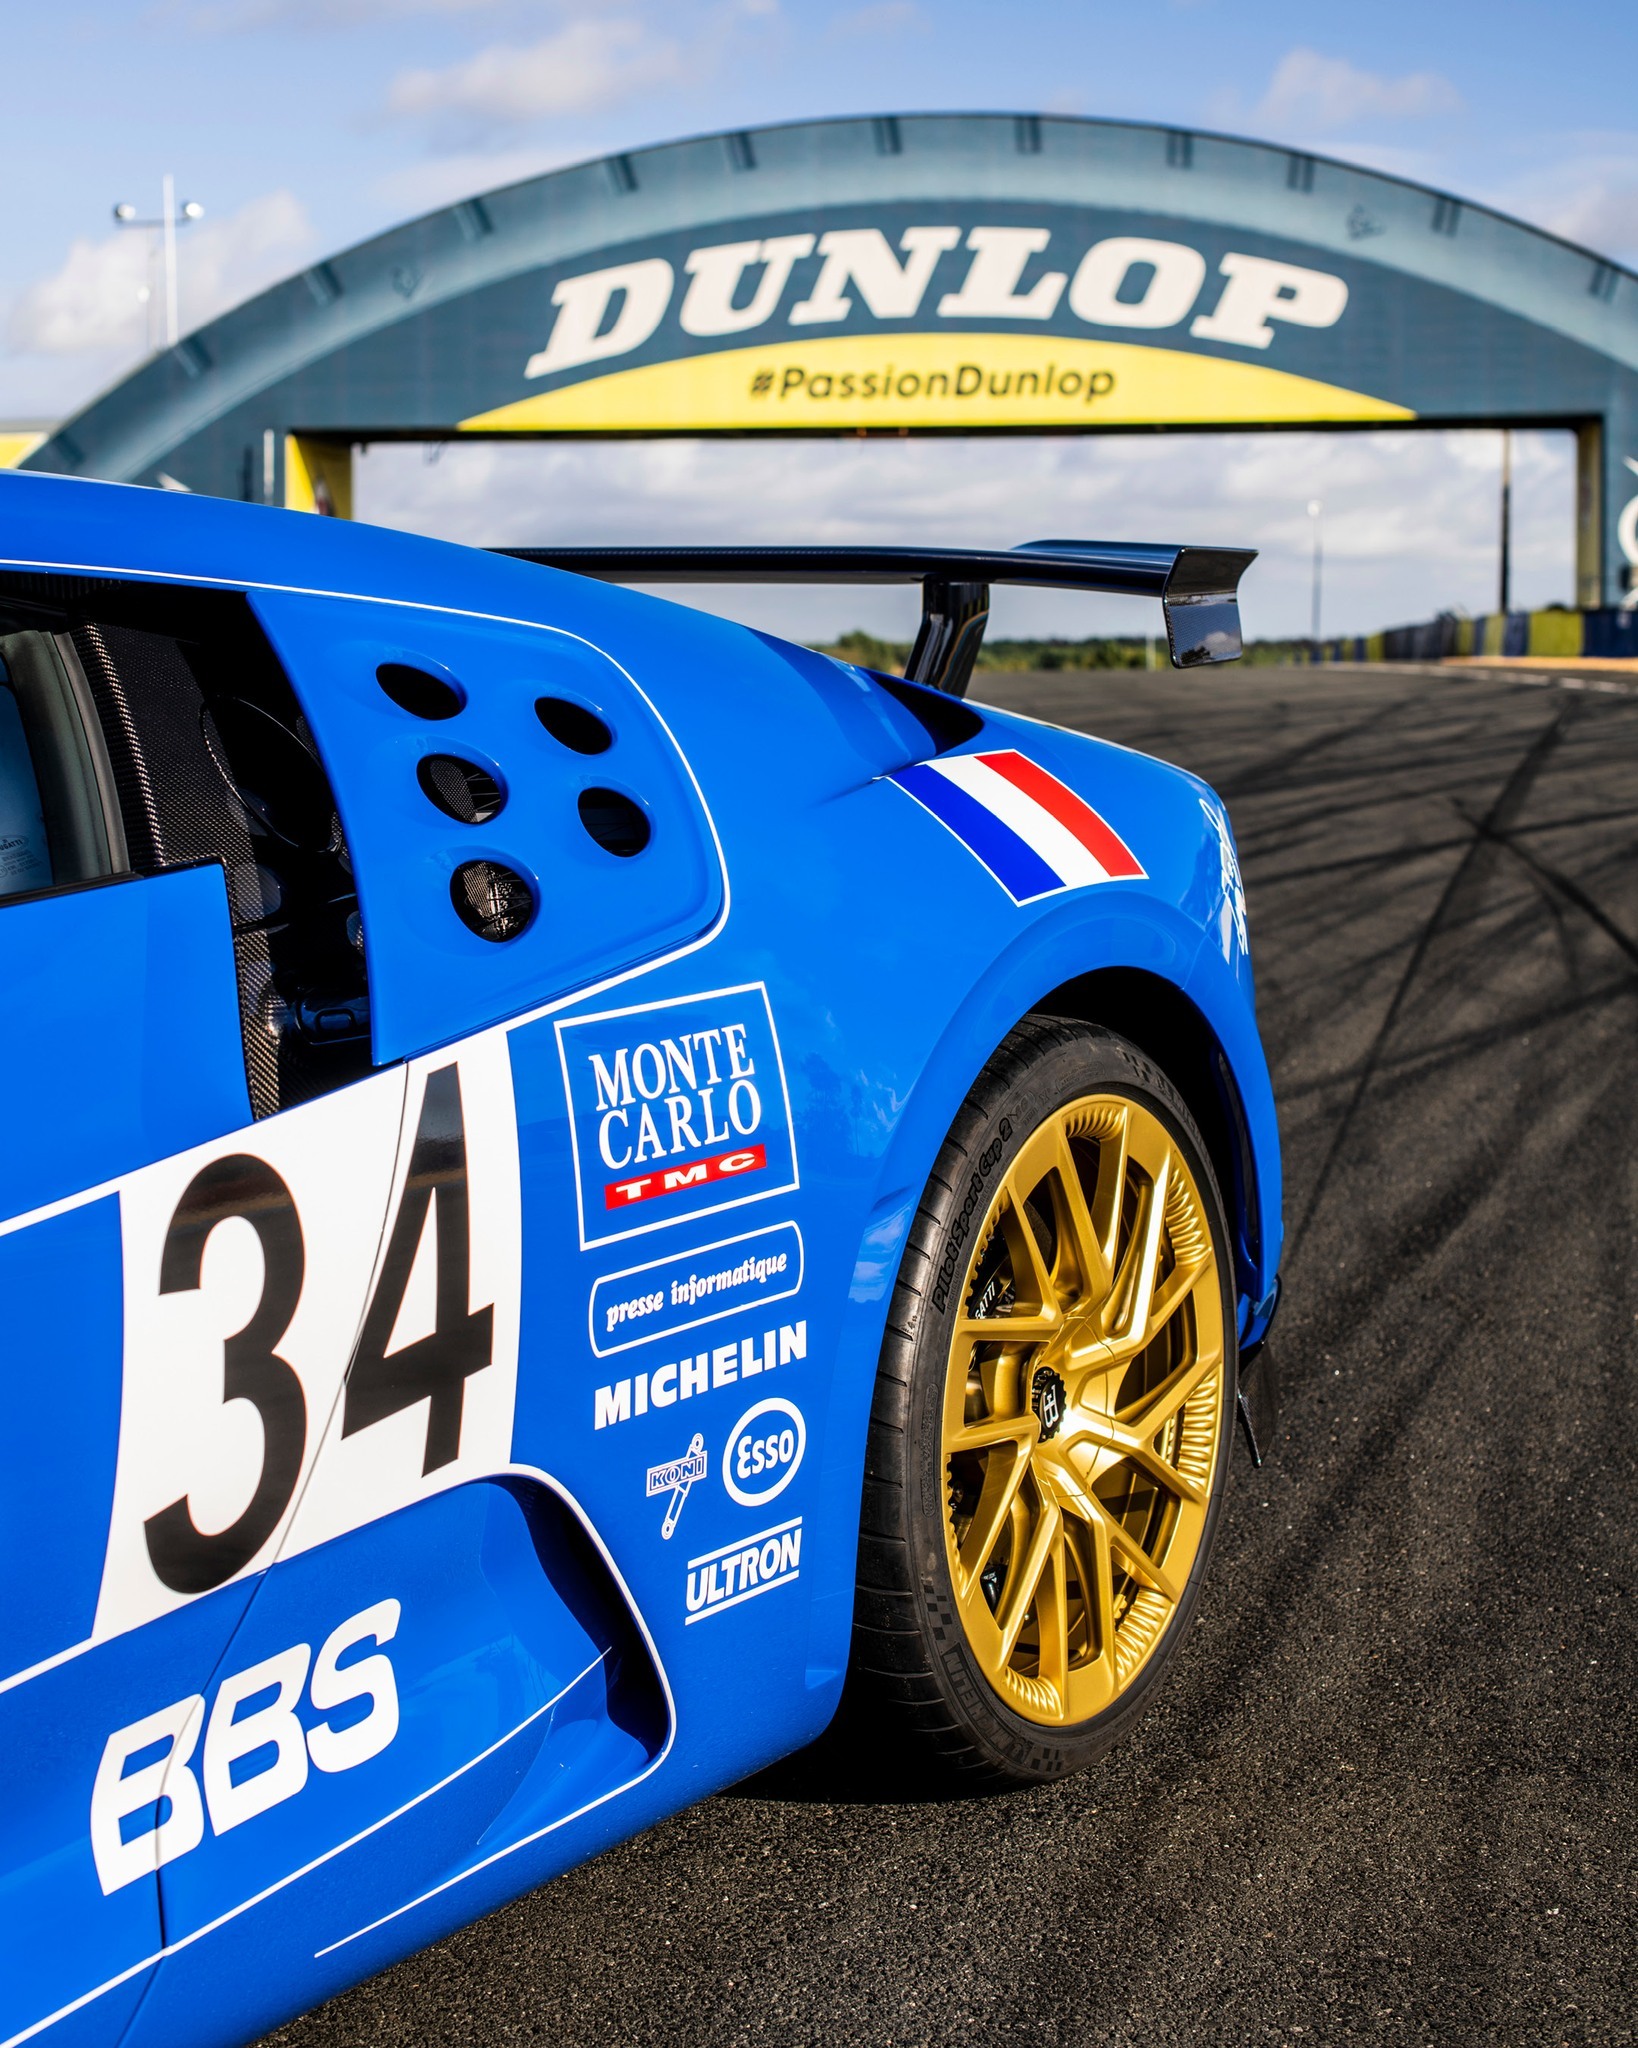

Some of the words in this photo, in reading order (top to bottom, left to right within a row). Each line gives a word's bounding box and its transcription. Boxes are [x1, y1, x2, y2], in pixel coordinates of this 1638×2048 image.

[524, 226, 1349, 379] DUNLOP
[750, 363, 1115, 405] #PassionDunlop
[589, 1023, 756, 1111] MONTE
[599, 1079, 762, 1169] CARLO
[978, 1135, 1003, 1178] Cup
[996, 1116, 1014, 1143] 2
[616, 1152, 756, 1200] TMC
[144, 1062, 494, 1594] 34
[607, 1291, 664, 1332] presse
[671, 1253, 787, 1305] informatique
[594, 1320, 807, 1430] MICHELIN
[651, 1458, 704, 1490] KONI
[686, 1528, 802, 1612] ULTRON
[91, 1599, 402, 1897] BBS
